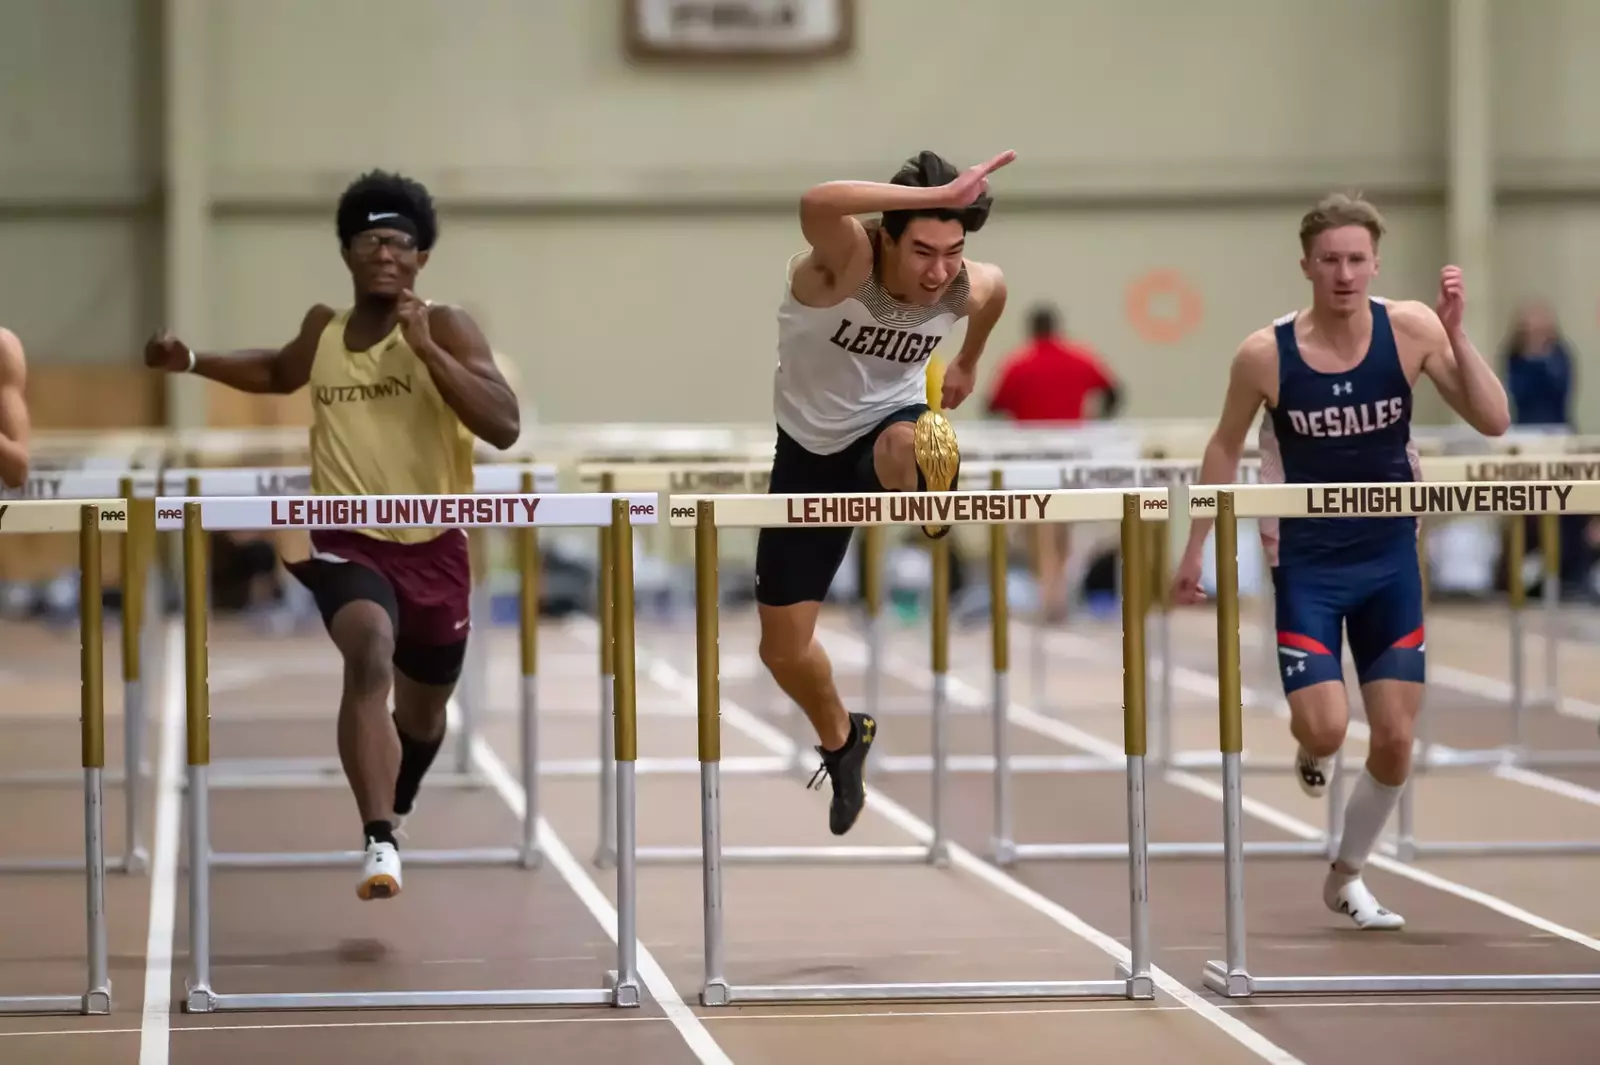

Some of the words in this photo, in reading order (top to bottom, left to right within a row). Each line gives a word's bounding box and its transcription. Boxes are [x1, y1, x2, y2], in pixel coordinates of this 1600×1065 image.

[830, 319, 942, 363] LEHIGH
[271, 498, 368, 525] LEHIGH
[375, 496, 541, 524] UNIVERSITY
[787, 494, 883, 523] LEHIGH
[890, 492, 1052, 521] UNIVERSITY
[1307, 486, 1403, 514] LEHIGH
[1409, 484, 1573, 513] UNIVERSITY
